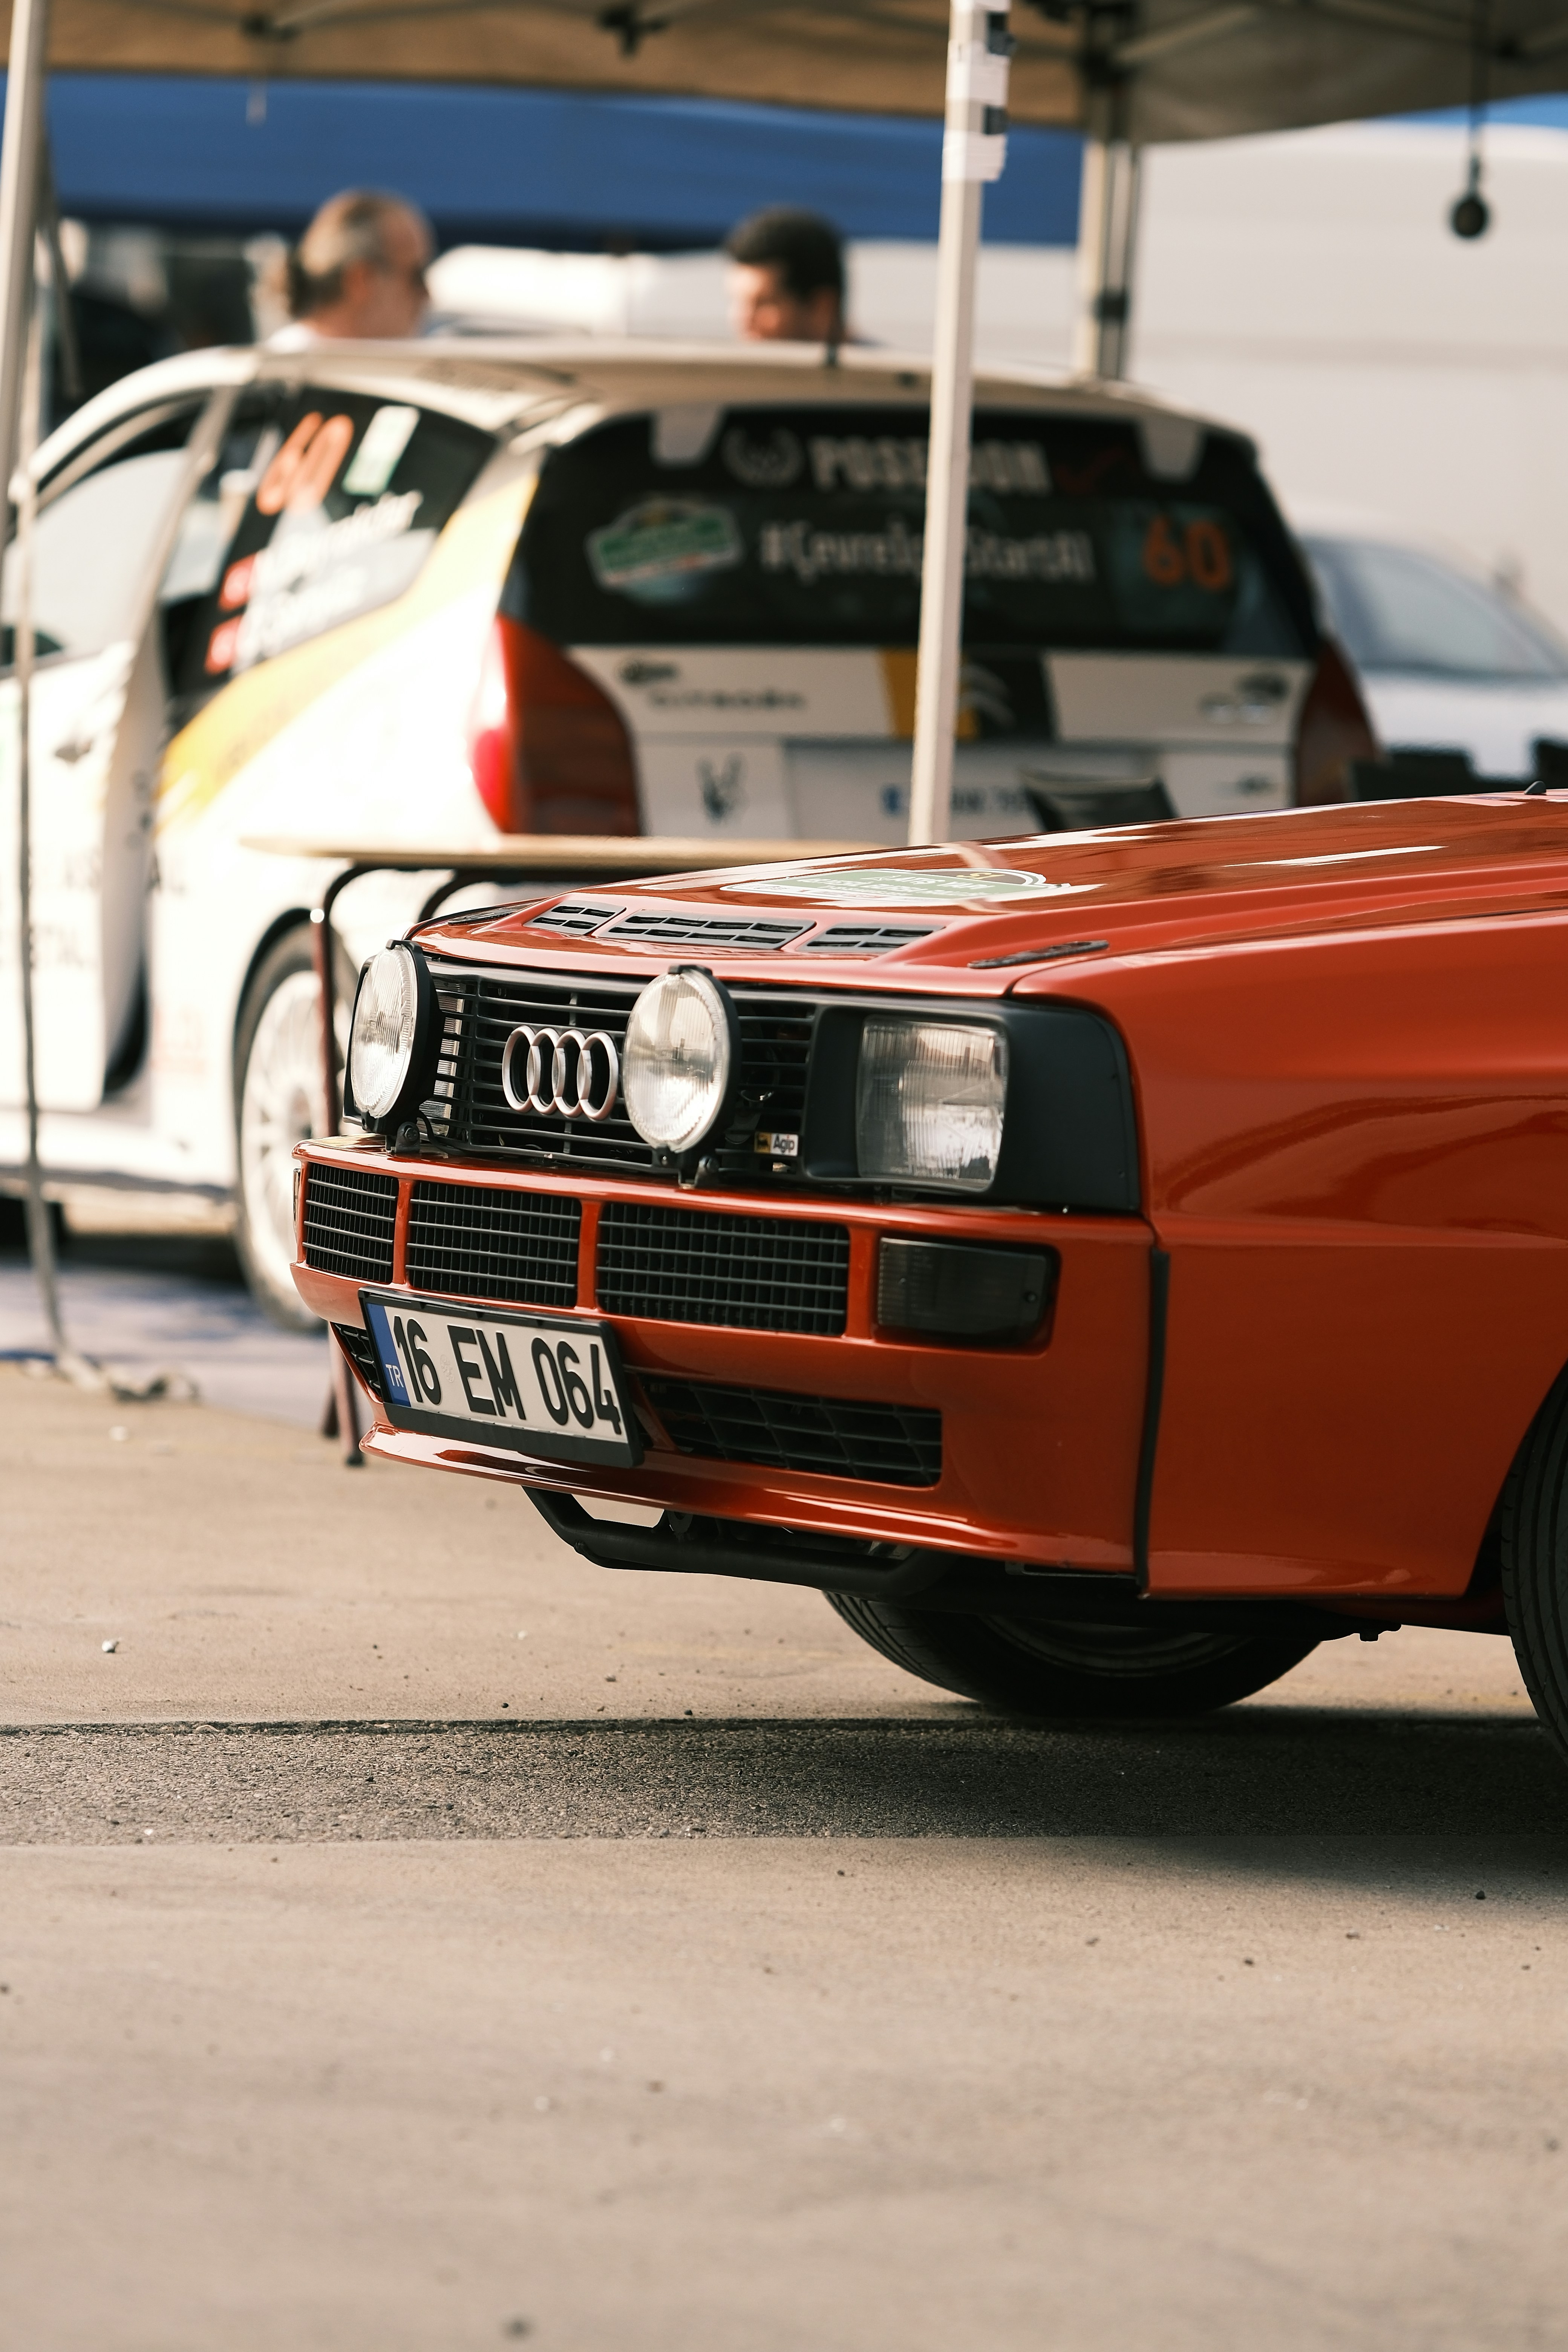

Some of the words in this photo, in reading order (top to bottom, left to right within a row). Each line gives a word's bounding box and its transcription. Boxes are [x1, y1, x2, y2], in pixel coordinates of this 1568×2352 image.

[1143, 516, 1230, 590] 60
[860, 884, 929, 892] BURSA
[890, 876, 946, 885] ATIŞ
[936, 881, 995, 890] YAPI
[773, 1134, 794, 1153] Agip
[385, 1363, 404, 1389] TR
[393, 1315, 442, 1406] 16
[447, 1324, 526, 1420] EM
[531, 1337, 622, 1435] 064
